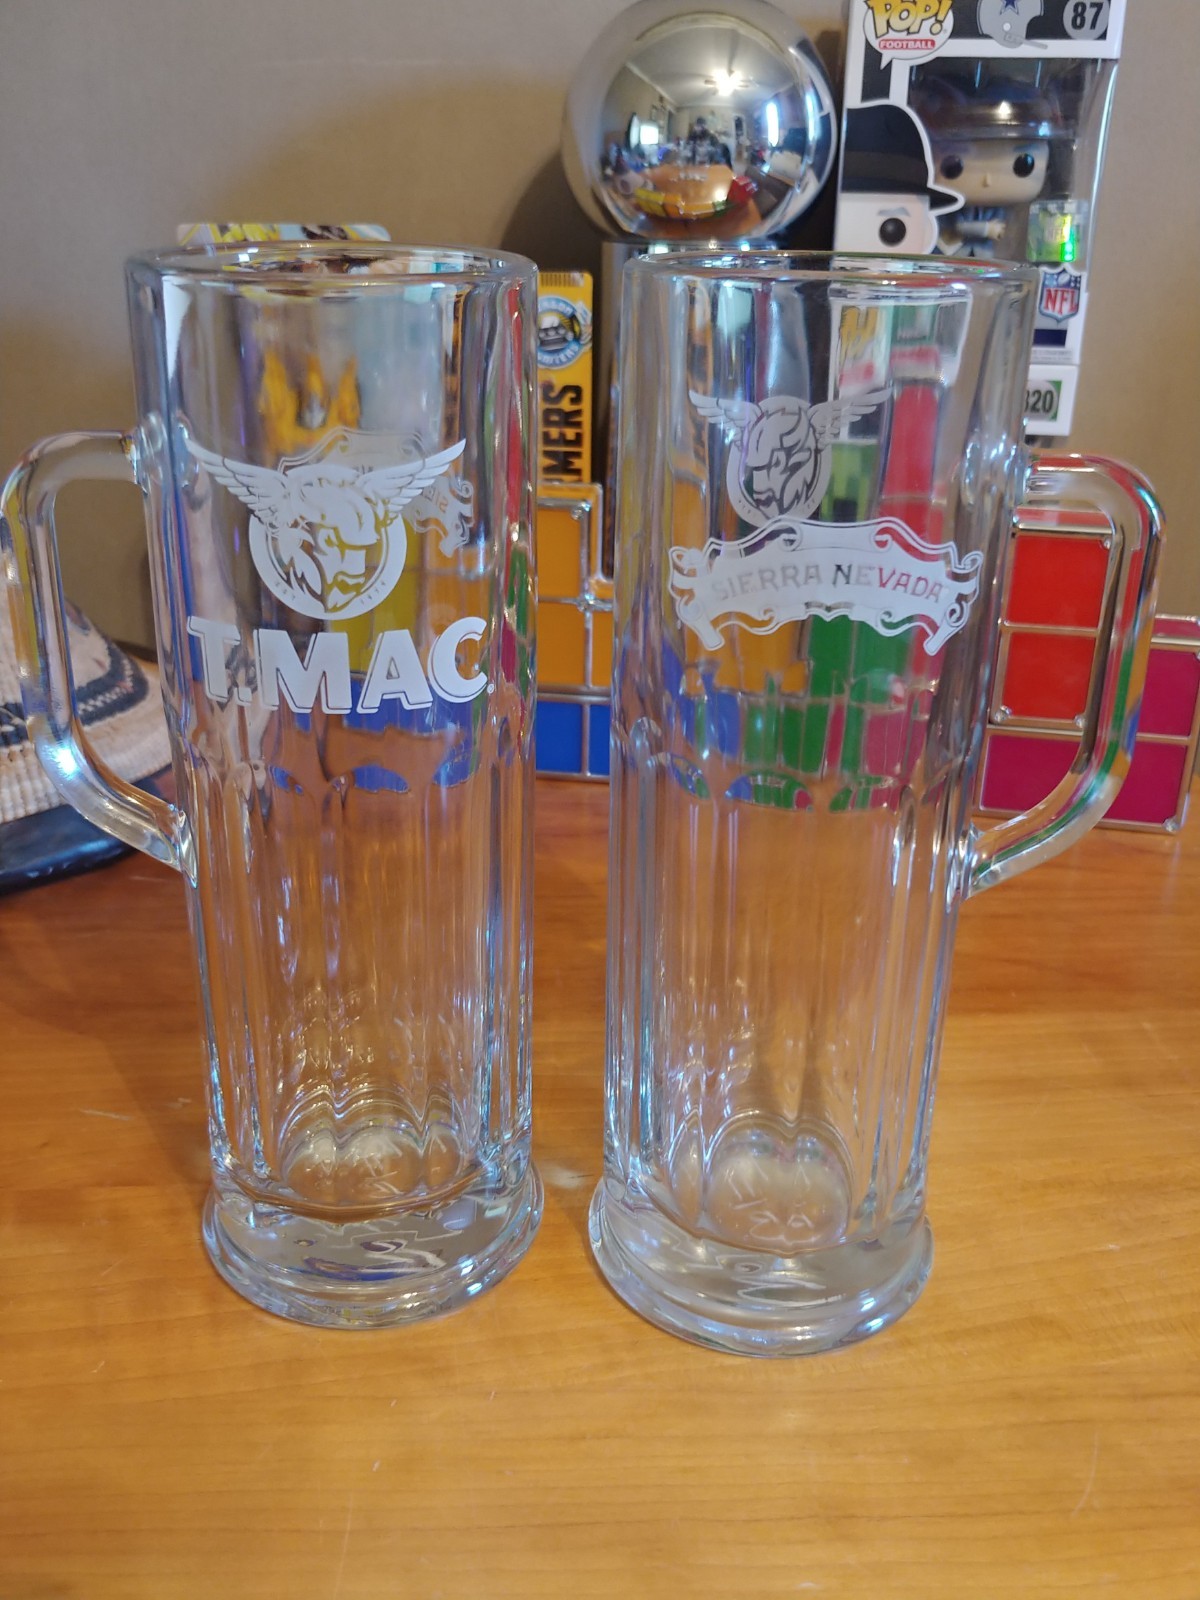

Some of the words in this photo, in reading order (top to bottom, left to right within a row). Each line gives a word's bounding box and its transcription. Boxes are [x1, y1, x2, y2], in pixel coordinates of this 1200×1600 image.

[864, 0, 953, 39] POP!
[1070, 1, 1101, 31] 87
[879, 39, 935, 49] FOOTBALL
[1044, 287, 1079, 316] NFL
[542, 379, 584, 483] MERS
[711, 563, 824, 601] SIERRA
[831, 563, 944, 602] NEVADA
